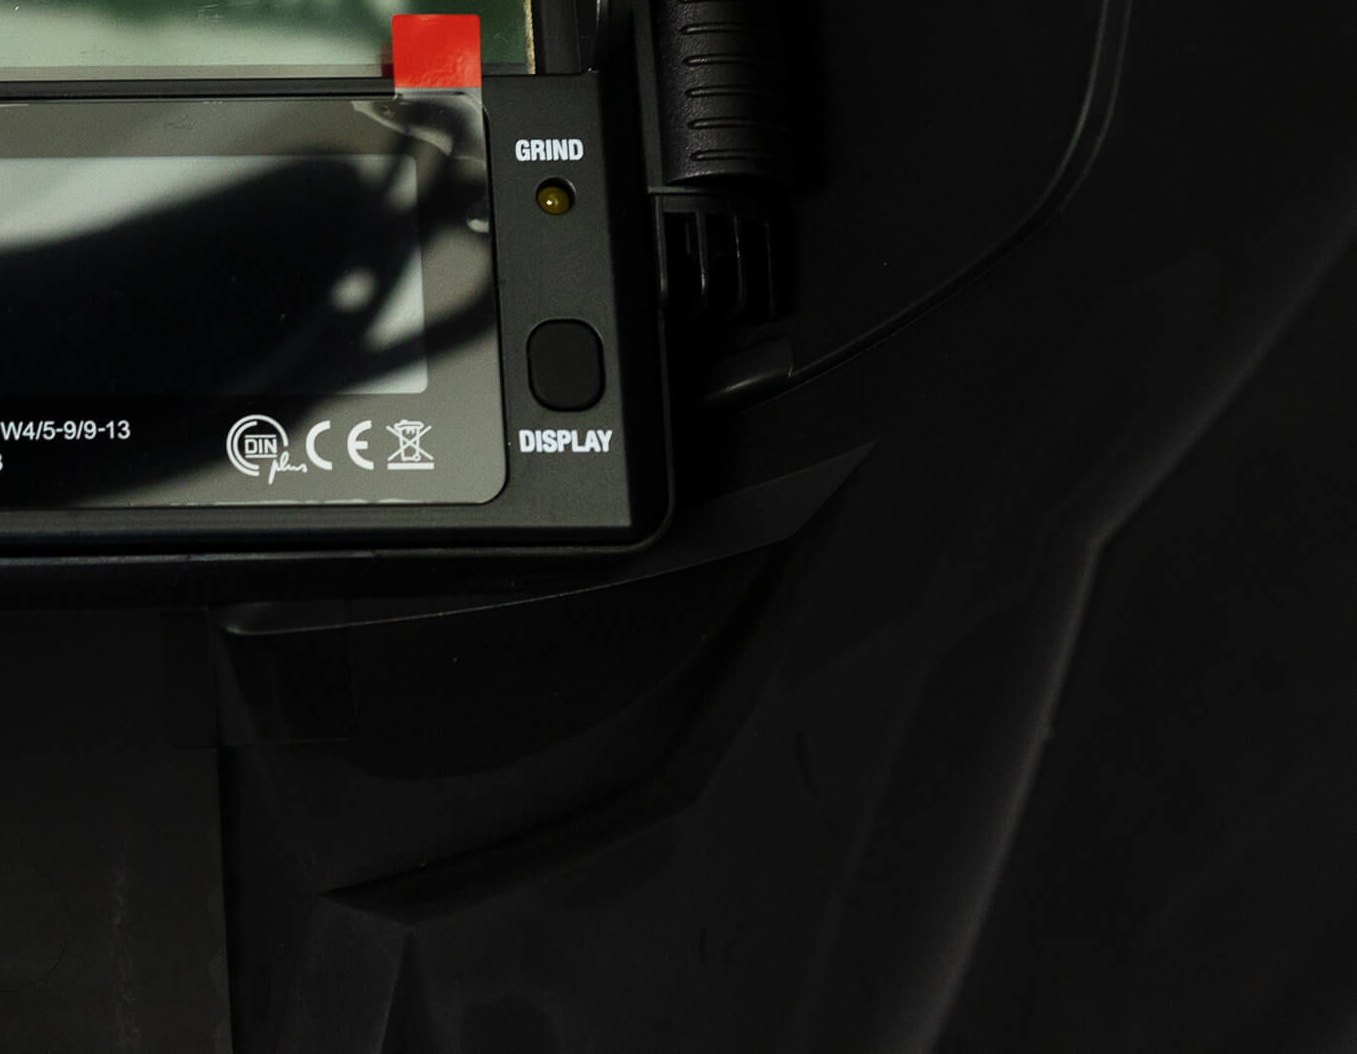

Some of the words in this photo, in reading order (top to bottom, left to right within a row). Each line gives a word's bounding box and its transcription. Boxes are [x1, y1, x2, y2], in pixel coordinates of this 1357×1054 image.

[515, 139, 584, 161] GRIND
[245, 438, 277, 454] DIN
[519, 430, 613, 452] DISPLAY
[268, 451, 307, 485] plus
